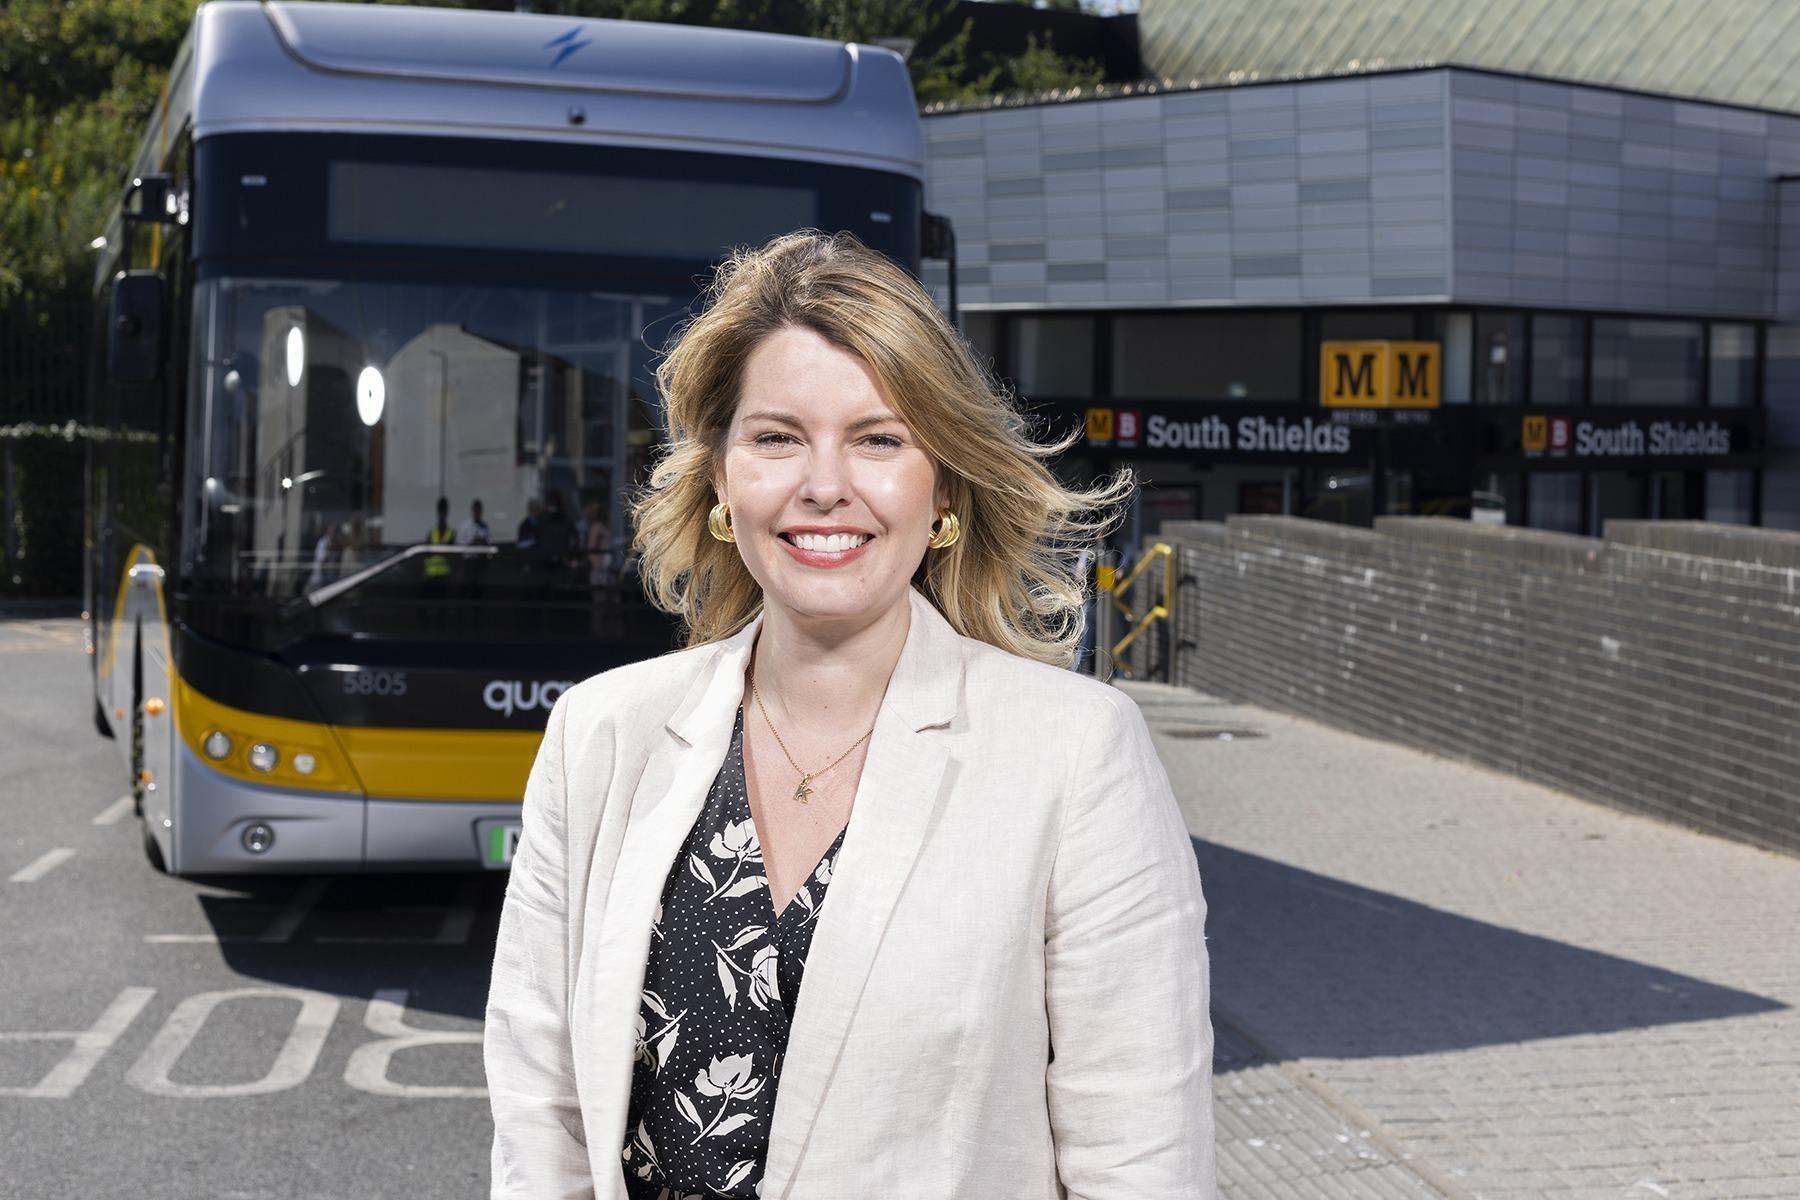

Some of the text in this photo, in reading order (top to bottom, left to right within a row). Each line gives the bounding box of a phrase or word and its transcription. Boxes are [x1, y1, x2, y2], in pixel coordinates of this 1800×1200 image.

[1335, 352, 1376, 397] M
[1397, 352, 1430, 398] M
[1119, 412, 1136, 438] B
[1147, 414, 1231, 449] South
[1237, 416, 1350, 453] Shields
[1552, 419, 1568, 447] B
[1575, 421, 1644, 455] South
[1649, 420, 1730, 454] Shields
[343, 671, 407, 696] 5805
[483, 680, 574, 718] qua
